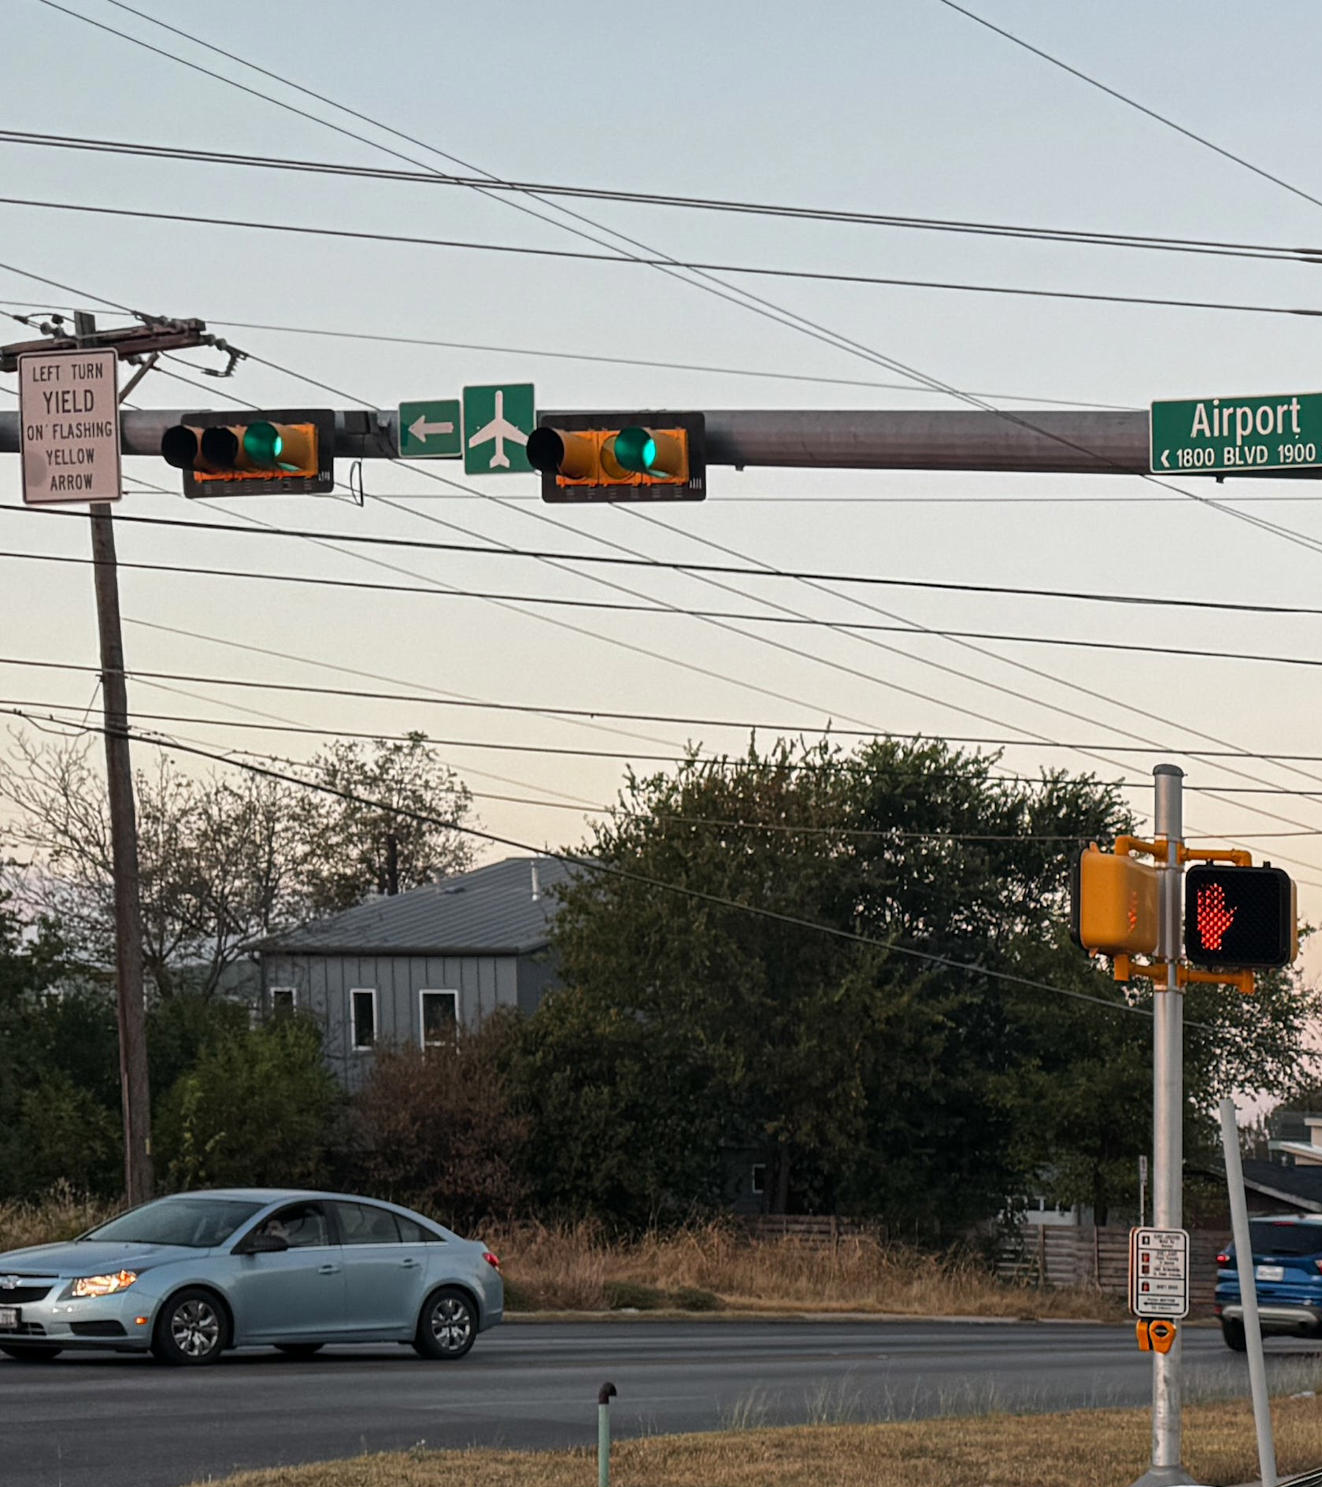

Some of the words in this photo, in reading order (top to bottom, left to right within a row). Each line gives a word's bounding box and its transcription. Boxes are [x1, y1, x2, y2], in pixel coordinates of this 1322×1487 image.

[32, 365, 61, 382] LEFT
[71, 363, 103, 380] TURN
[43, 389, 94, 415] YIELD
[27, 425, 43, 441] ON
[53, 421, 113, 440] FLASHING
[1190, 397, 1301, 446] Airport
[46, 448, 95, 466] YELLOW
[1176, 448, 1215, 468] 1800
[1223, 446, 1268, 465] BLVD
[1277, 443, 1316, 463] 1900
[50, 474, 93, 491] ARROW
